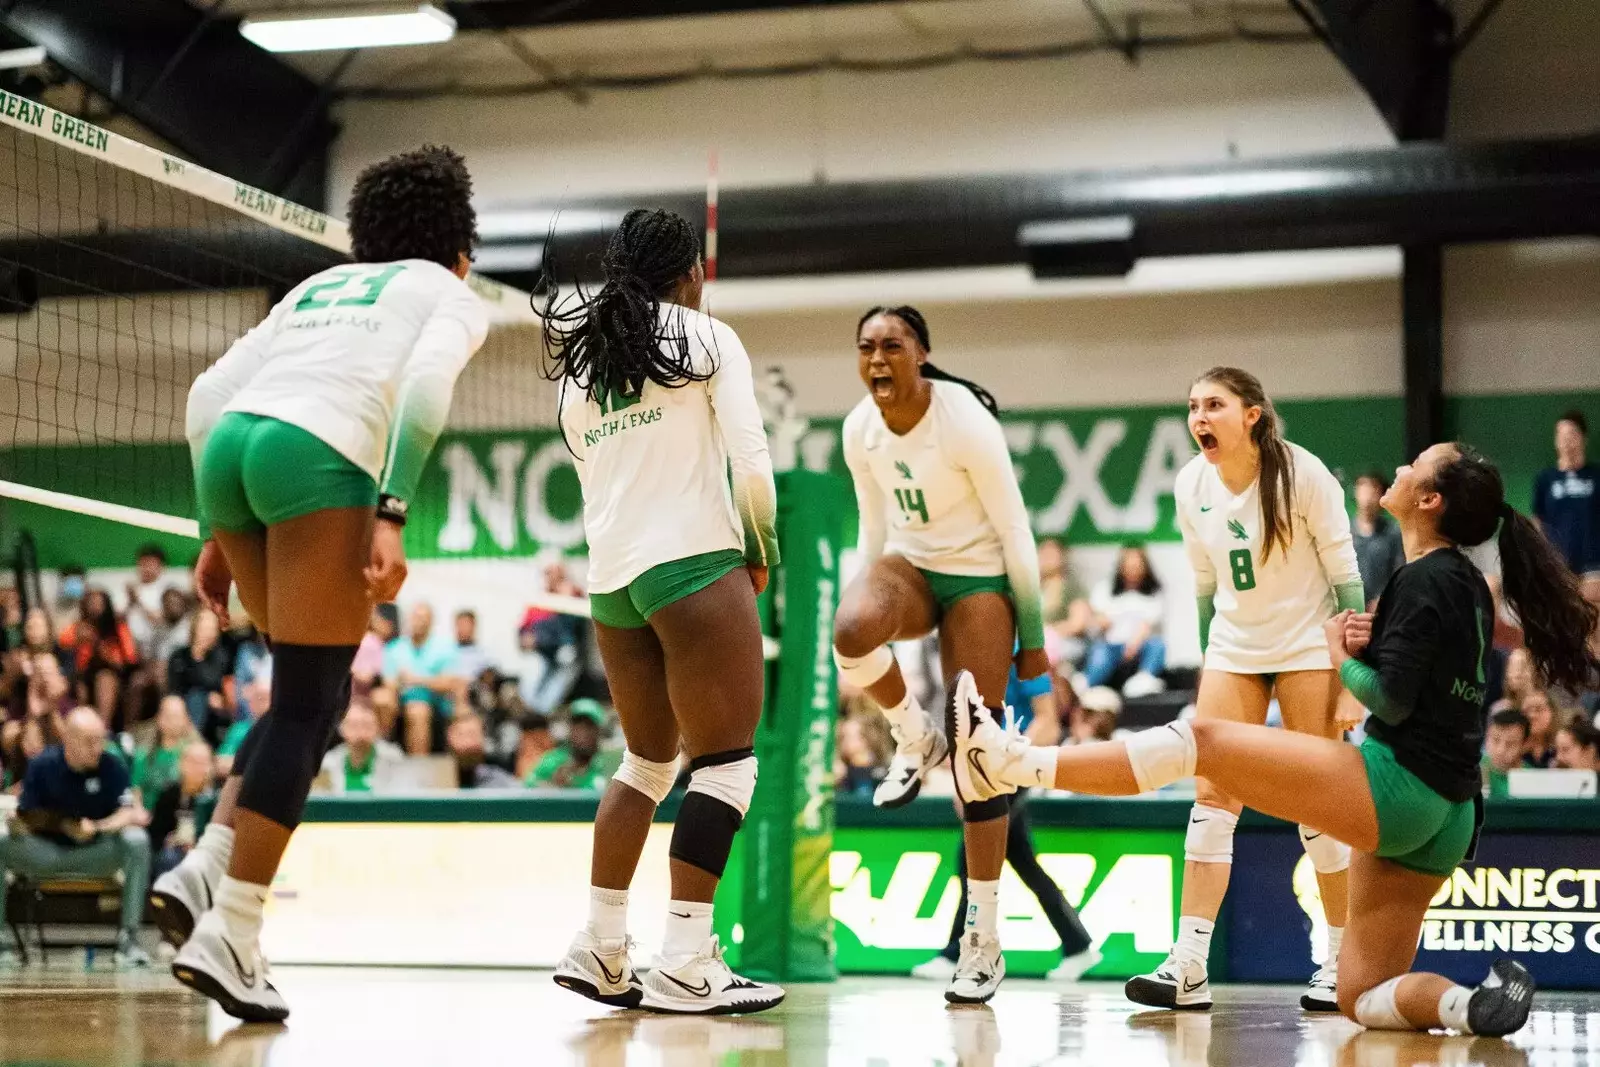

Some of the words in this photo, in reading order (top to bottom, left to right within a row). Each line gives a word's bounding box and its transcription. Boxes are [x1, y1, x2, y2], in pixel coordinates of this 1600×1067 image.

[52, 112, 109, 152] GREEN
[234, 185, 276, 216] MEAN
[281, 203, 327, 235] GREEN
[621, 406, 662, 430] TEXAS
[894, 489, 929, 524] 14
[1229, 549, 1257, 592] 8
[1417, 920, 1575, 953] ELLNESS
